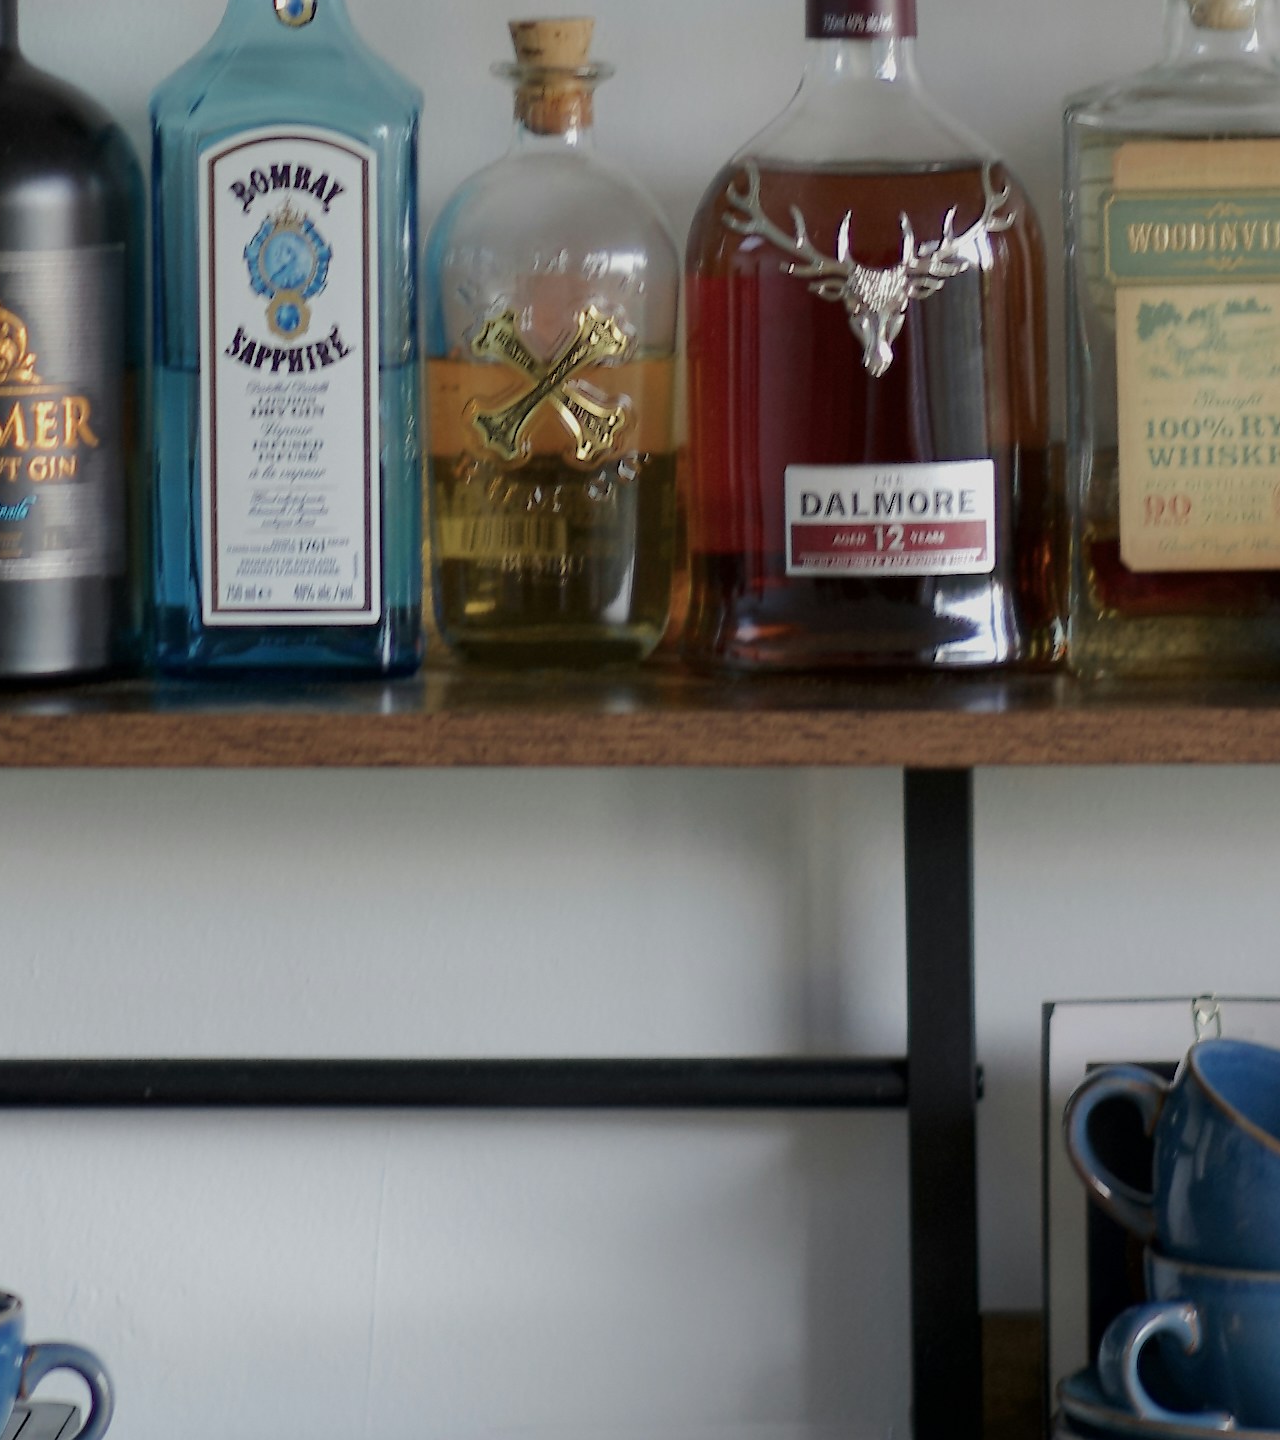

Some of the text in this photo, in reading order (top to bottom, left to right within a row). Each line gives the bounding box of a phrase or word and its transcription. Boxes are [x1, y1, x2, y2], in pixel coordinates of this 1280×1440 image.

[230, 164, 344, 213] BOMBAY
[224, 326, 351, 372] SAPPHIRE
[1146, 415, 1234, 440] 100%
[28, 454, 78, 482] GIN
[801, 489, 977, 516] DALMORE
[872, 524, 905, 551] 12
